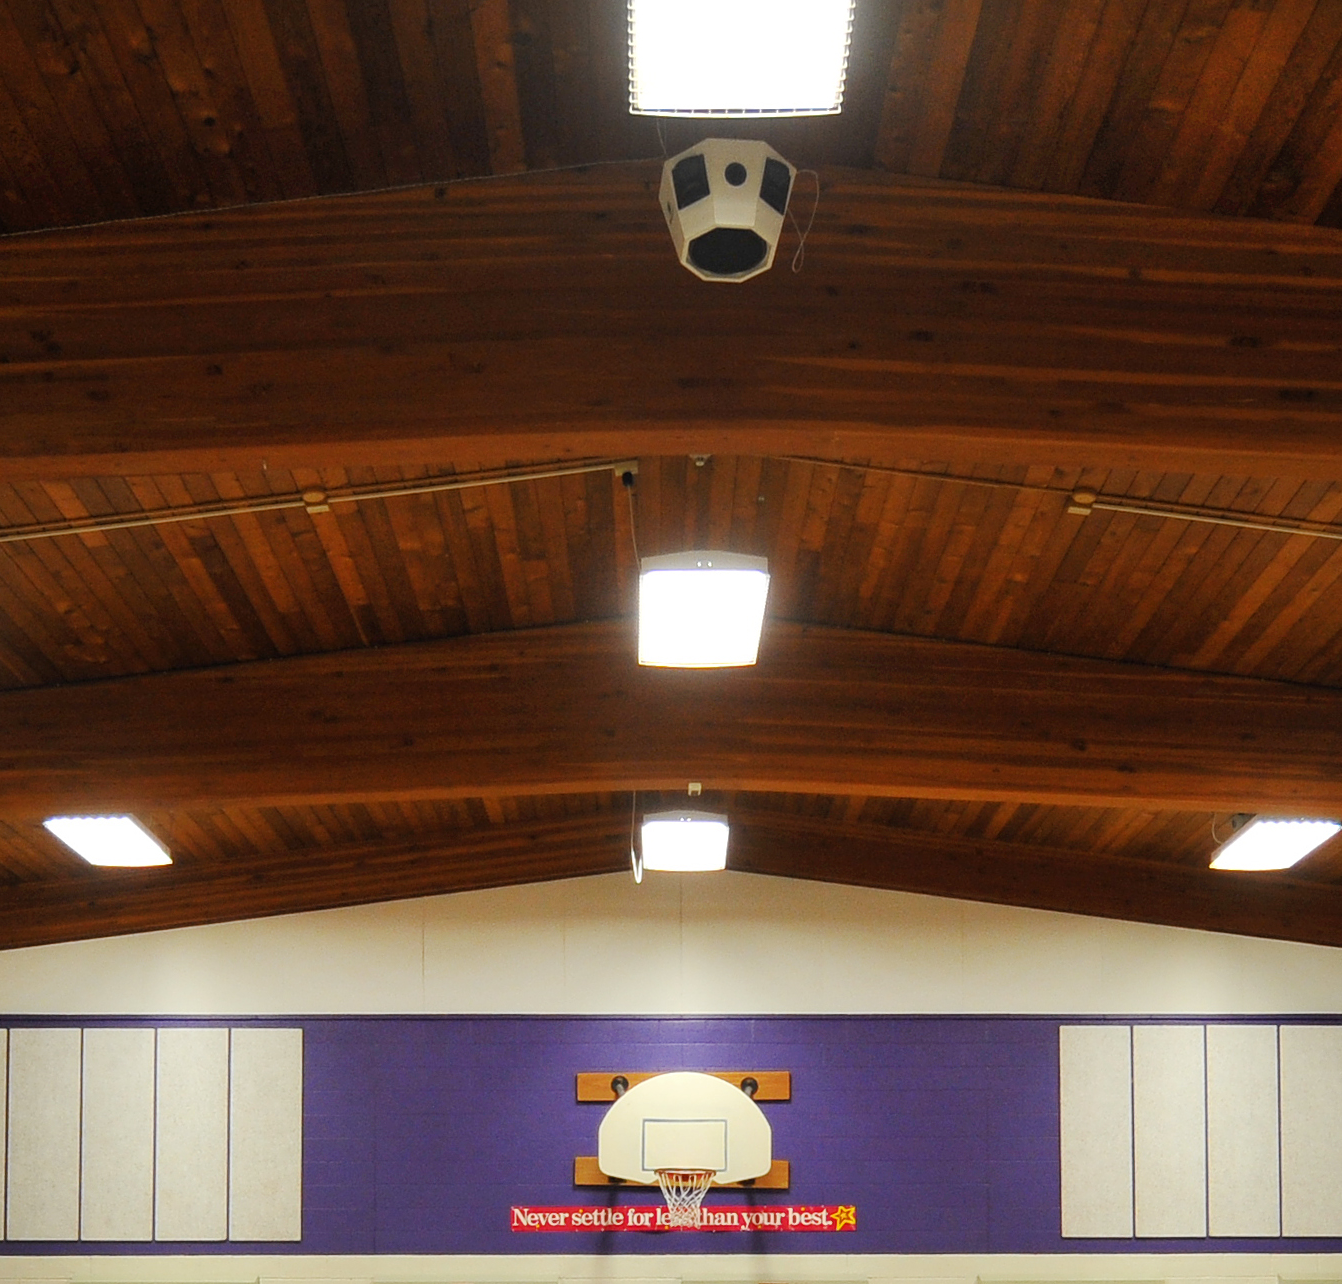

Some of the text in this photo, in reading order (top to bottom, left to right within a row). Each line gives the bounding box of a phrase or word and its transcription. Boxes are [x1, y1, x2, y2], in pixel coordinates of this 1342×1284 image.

[512, 1207, 569, 1227] Never
[571, 1207, 624, 1226] settle
[627, 1208, 654, 1226] for
[699, 1207, 740, 1226] than
[741, 1211, 786, 1231] your
[787, 1207, 833, 1226] best.
